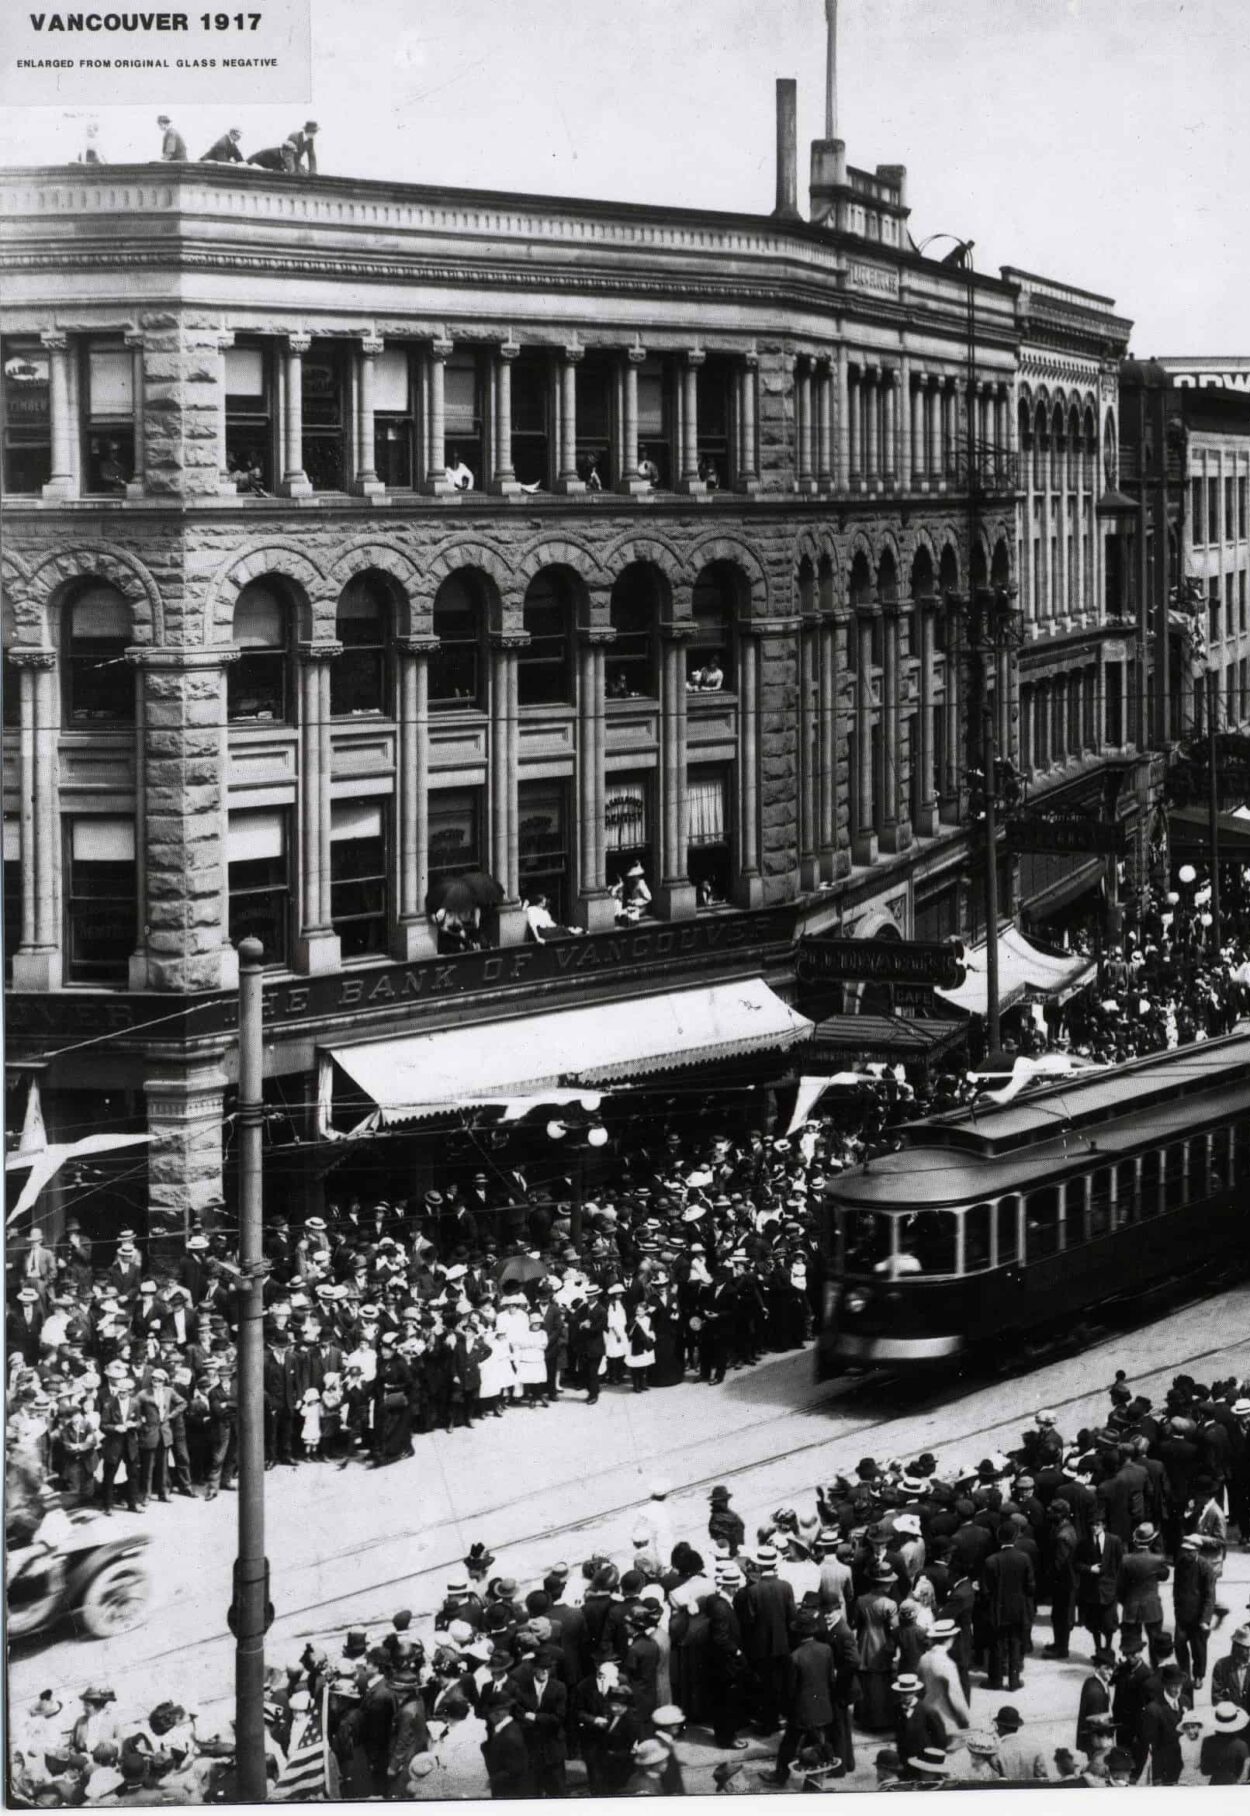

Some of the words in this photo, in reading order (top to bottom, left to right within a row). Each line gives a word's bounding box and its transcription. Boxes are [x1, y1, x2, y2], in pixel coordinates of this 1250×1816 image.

[337, 964, 459, 1005] BANK
[481, 953, 534, 983] OF
[553, 915, 773, 970] VANCOUVER
[896, 990, 934, 1005] CAFE
